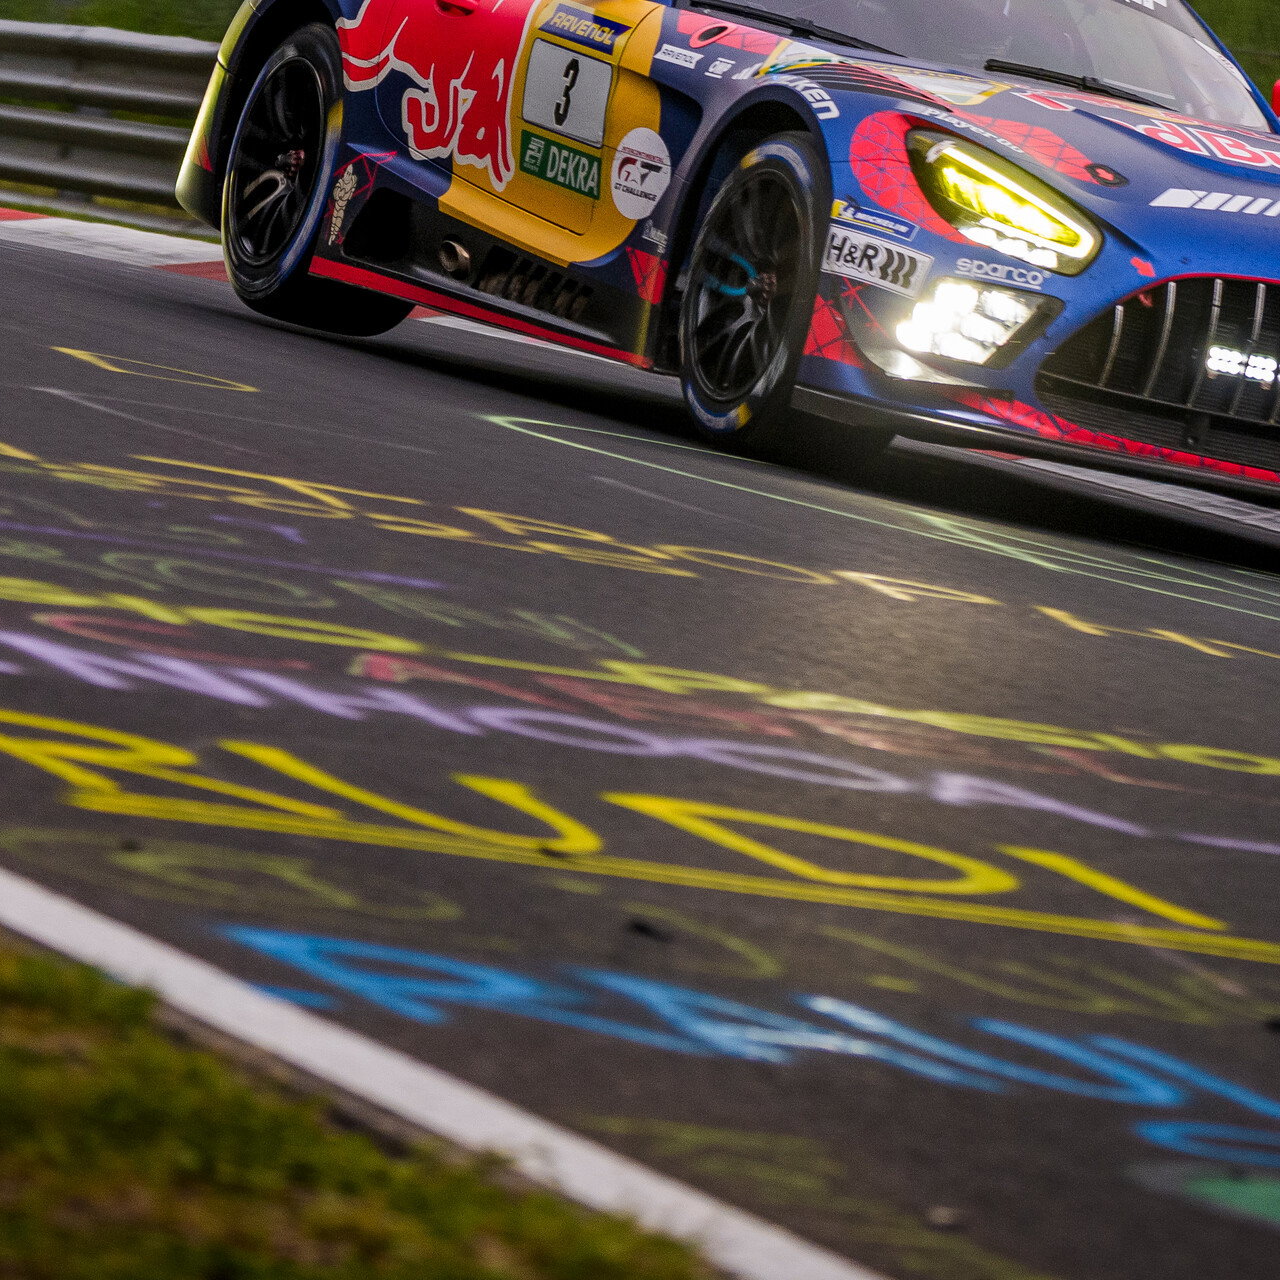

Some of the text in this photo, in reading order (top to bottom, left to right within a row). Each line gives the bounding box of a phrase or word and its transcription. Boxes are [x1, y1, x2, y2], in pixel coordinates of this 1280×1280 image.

[549, 8, 617, 47] RAVENOL
[553, 57, 580, 127] 3
[545, 145, 599, 196] DEKRA
[826, 231, 880, 272] H&R
[955, 258, 1043, 287] sparco
